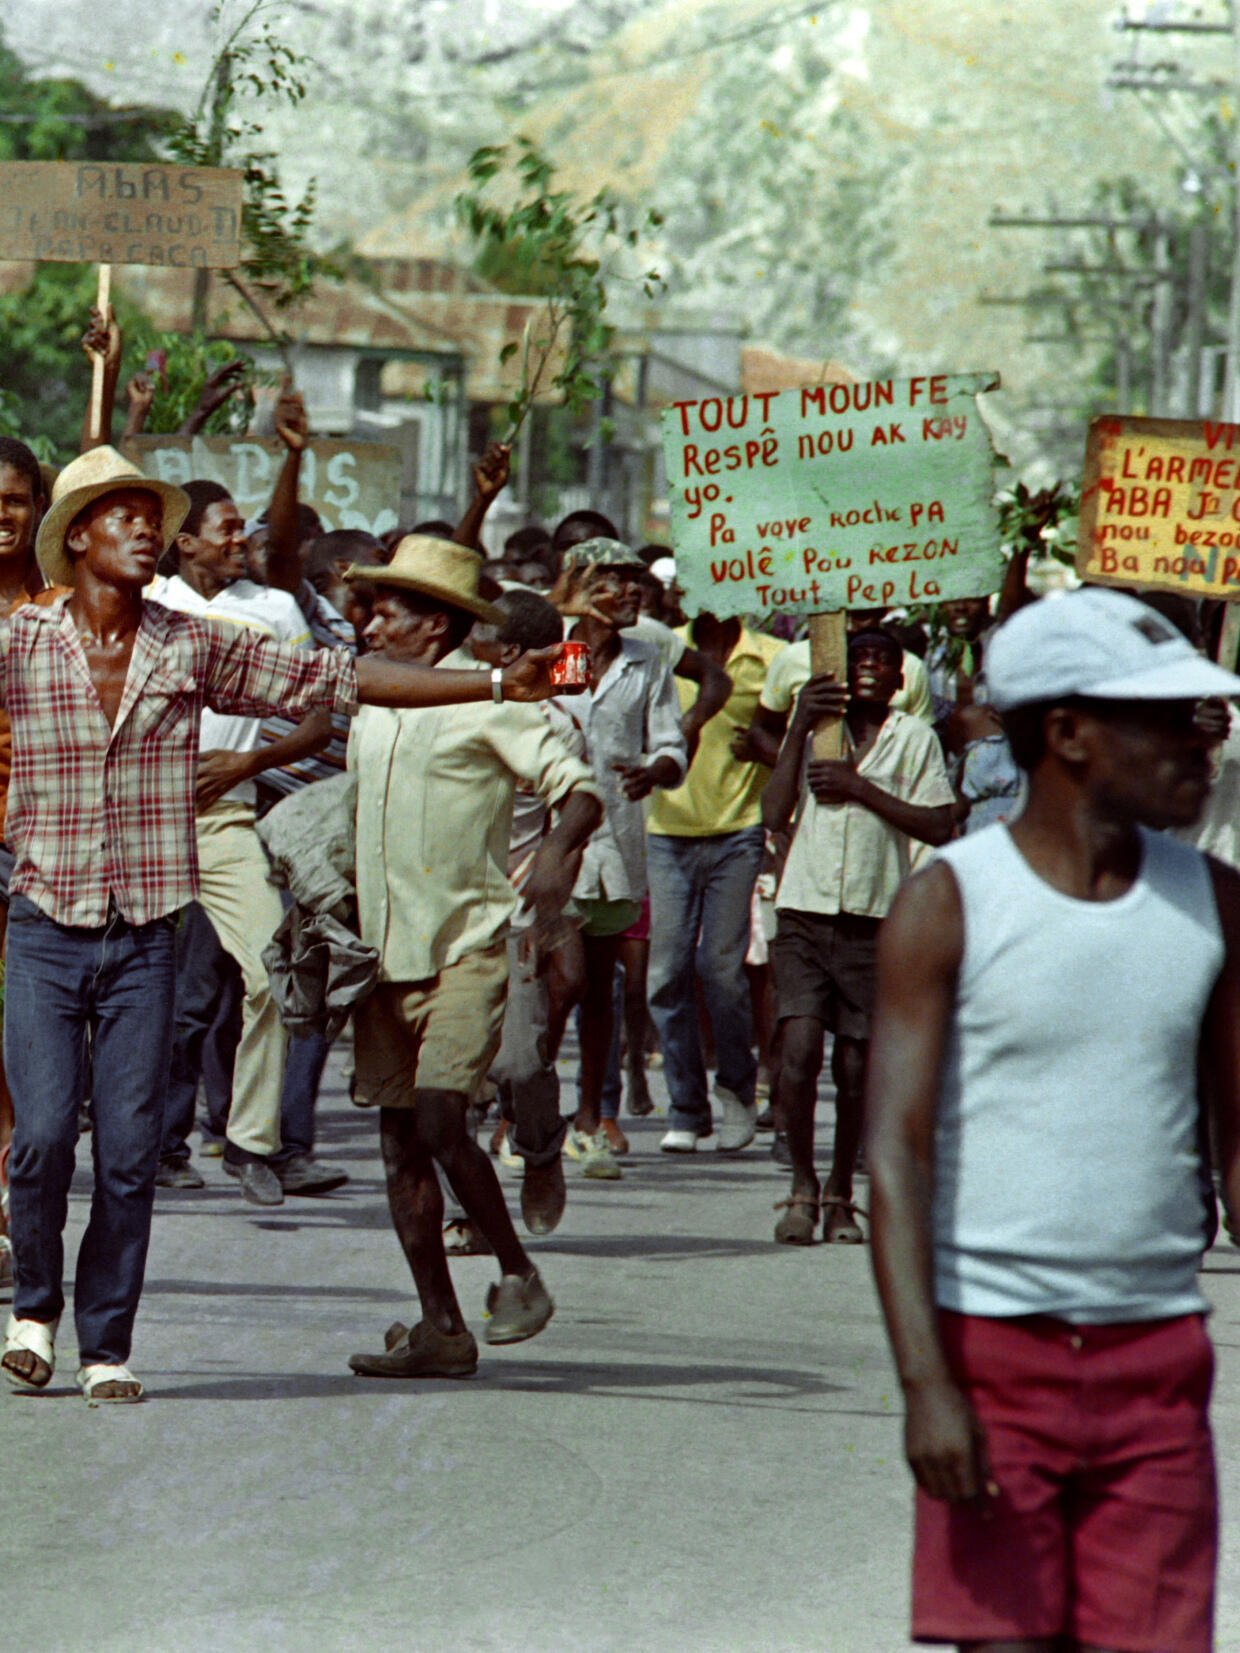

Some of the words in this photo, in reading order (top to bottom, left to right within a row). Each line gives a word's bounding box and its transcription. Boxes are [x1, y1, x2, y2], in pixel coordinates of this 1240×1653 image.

[673, 391, 780, 436] TOUT
[800, 379, 895, 419] MOUN
[909, 374, 950, 408] FE
[871, 422, 907, 447] AK
[1203, 421, 1240, 451] VI
[910, 501, 945, 528] PA
[1106, 486, 1173, 519] ABA
[1102, 523, 1151, 541] nou
[1100, 546, 1141, 574] Ba
